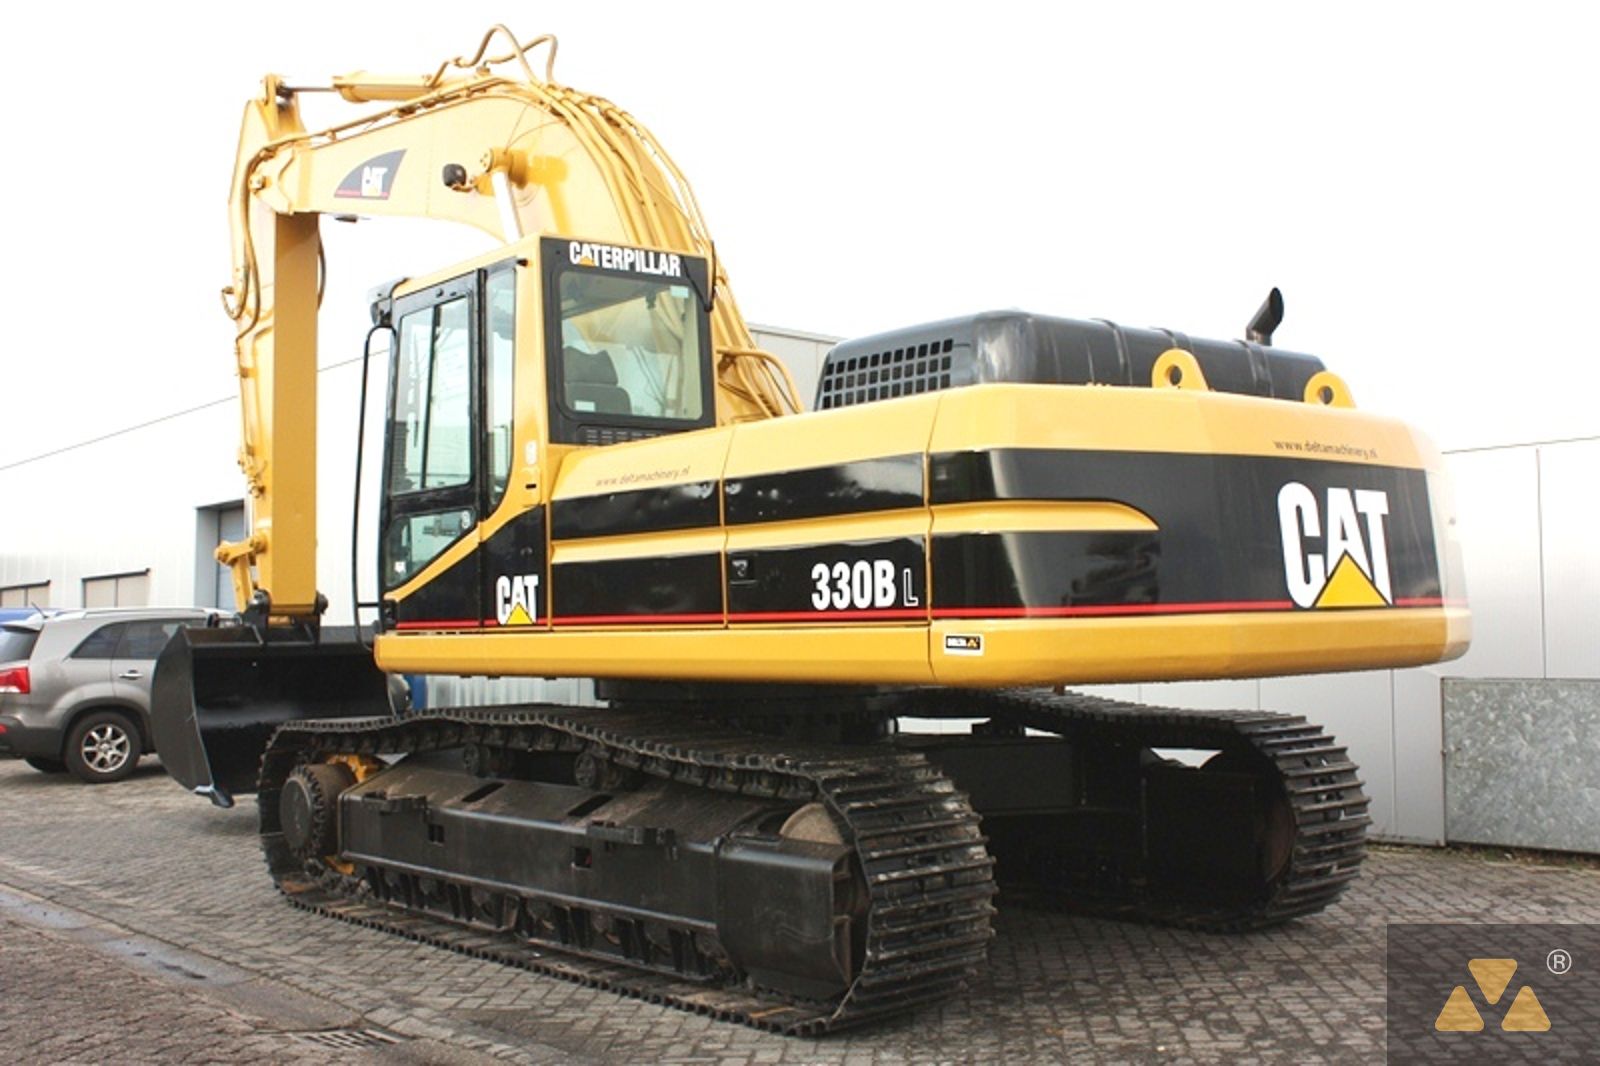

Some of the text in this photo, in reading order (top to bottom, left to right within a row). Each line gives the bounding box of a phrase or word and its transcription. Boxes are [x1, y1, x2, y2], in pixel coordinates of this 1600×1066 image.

[361, 166, 388, 197] CAT
[569, 241, 681, 277] CATERPILLAR
[1277, 481, 1393, 608] CAT
[496, 574, 539, 625] CAT
[811, 560, 919, 610] 330B L
